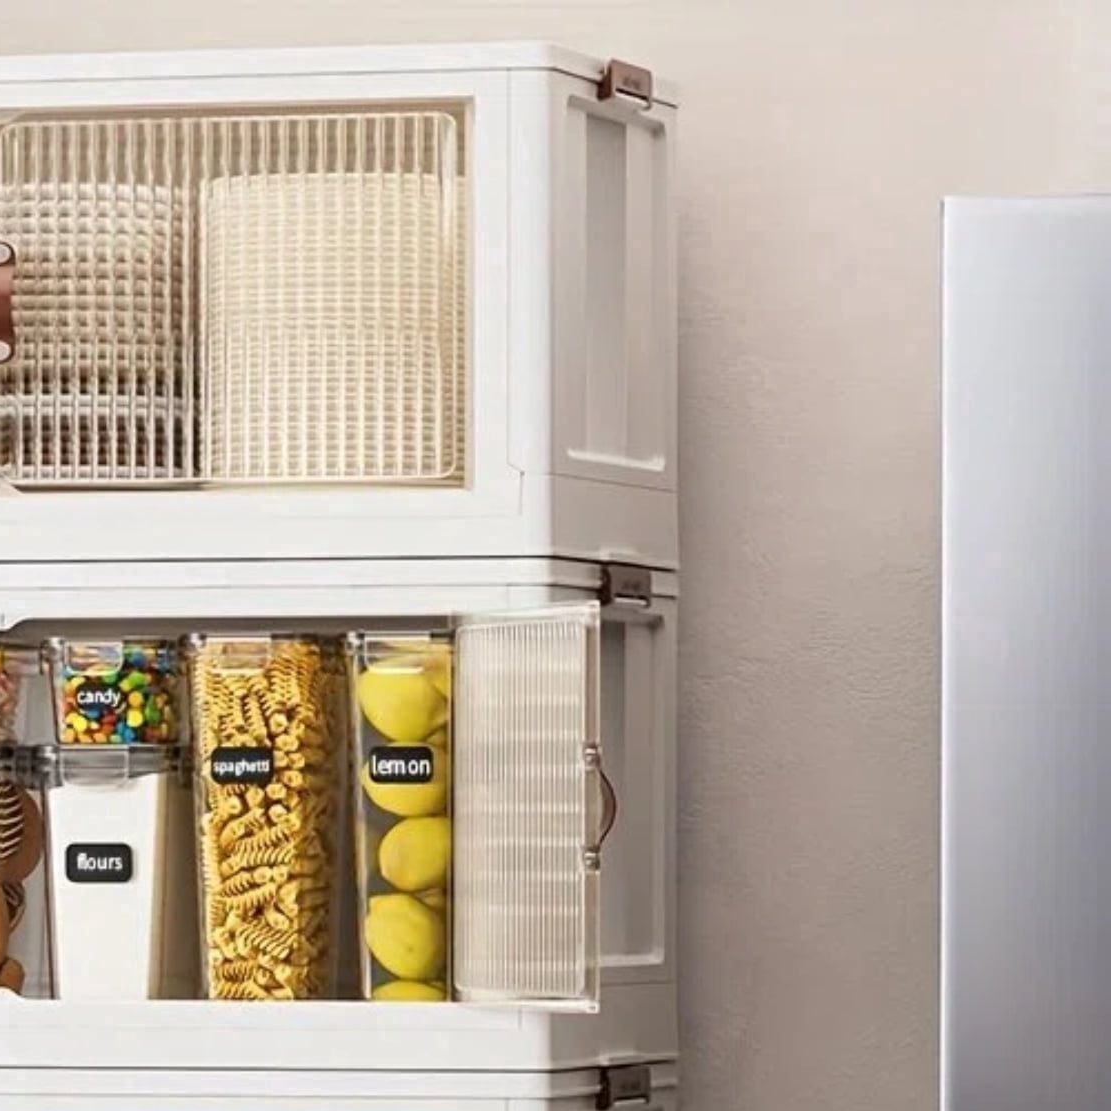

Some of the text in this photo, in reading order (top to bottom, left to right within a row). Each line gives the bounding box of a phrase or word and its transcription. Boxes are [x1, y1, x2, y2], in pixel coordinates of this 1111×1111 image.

[77, 689, 120, 707] candy
[372, 755, 430, 775] lemon
[77, 853, 123, 871] flours
